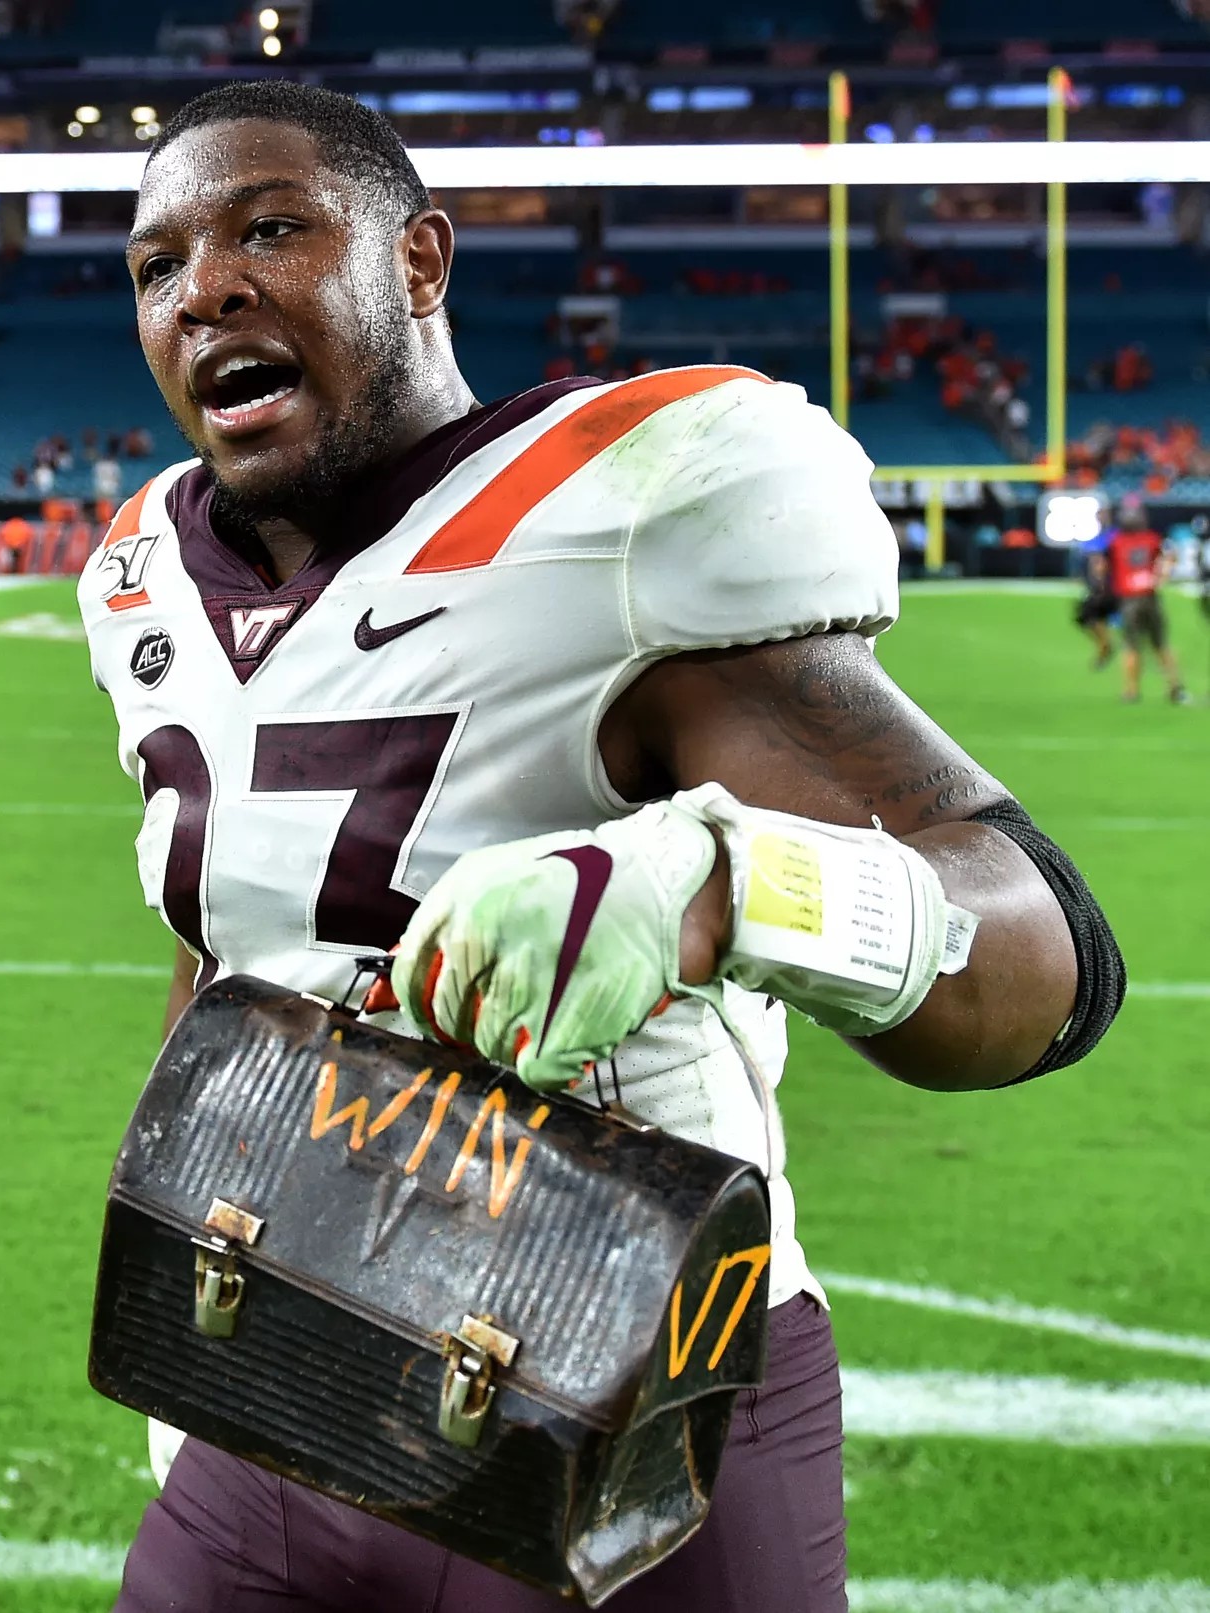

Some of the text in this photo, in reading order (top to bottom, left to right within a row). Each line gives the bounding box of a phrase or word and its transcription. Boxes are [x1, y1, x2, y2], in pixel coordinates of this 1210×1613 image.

[135, 636, 167, 670] ACC
[229, 604, 294, 655] VT
[309, 1030, 551, 1219] WIN
[668, 1244, 772, 1381] VT
